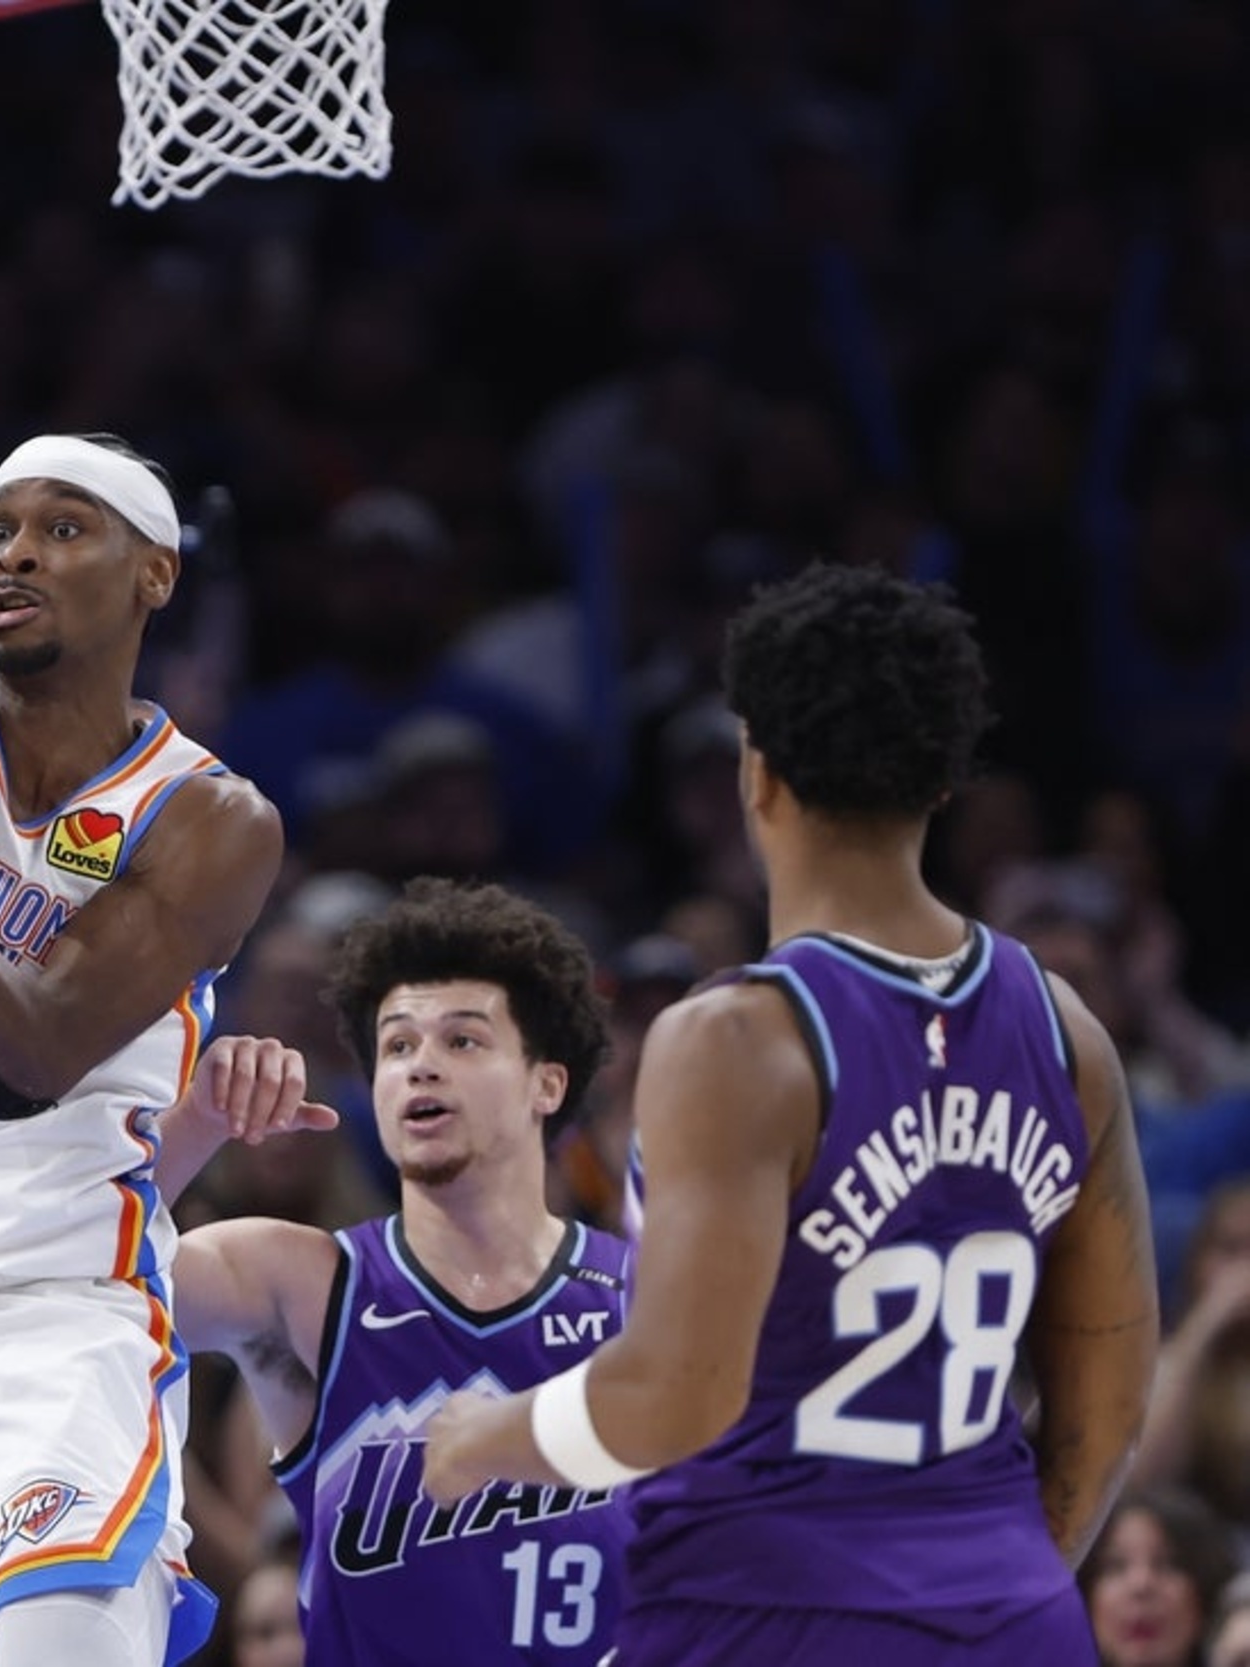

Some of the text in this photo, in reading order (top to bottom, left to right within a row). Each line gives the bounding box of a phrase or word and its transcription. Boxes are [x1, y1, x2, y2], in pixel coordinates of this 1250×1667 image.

[542, 1311, 610, 1346] LVT
[793, 1230, 1036, 1466] 28
[0, 1487, 61, 1546] OKC
[502, 1540, 603, 1647] 13
